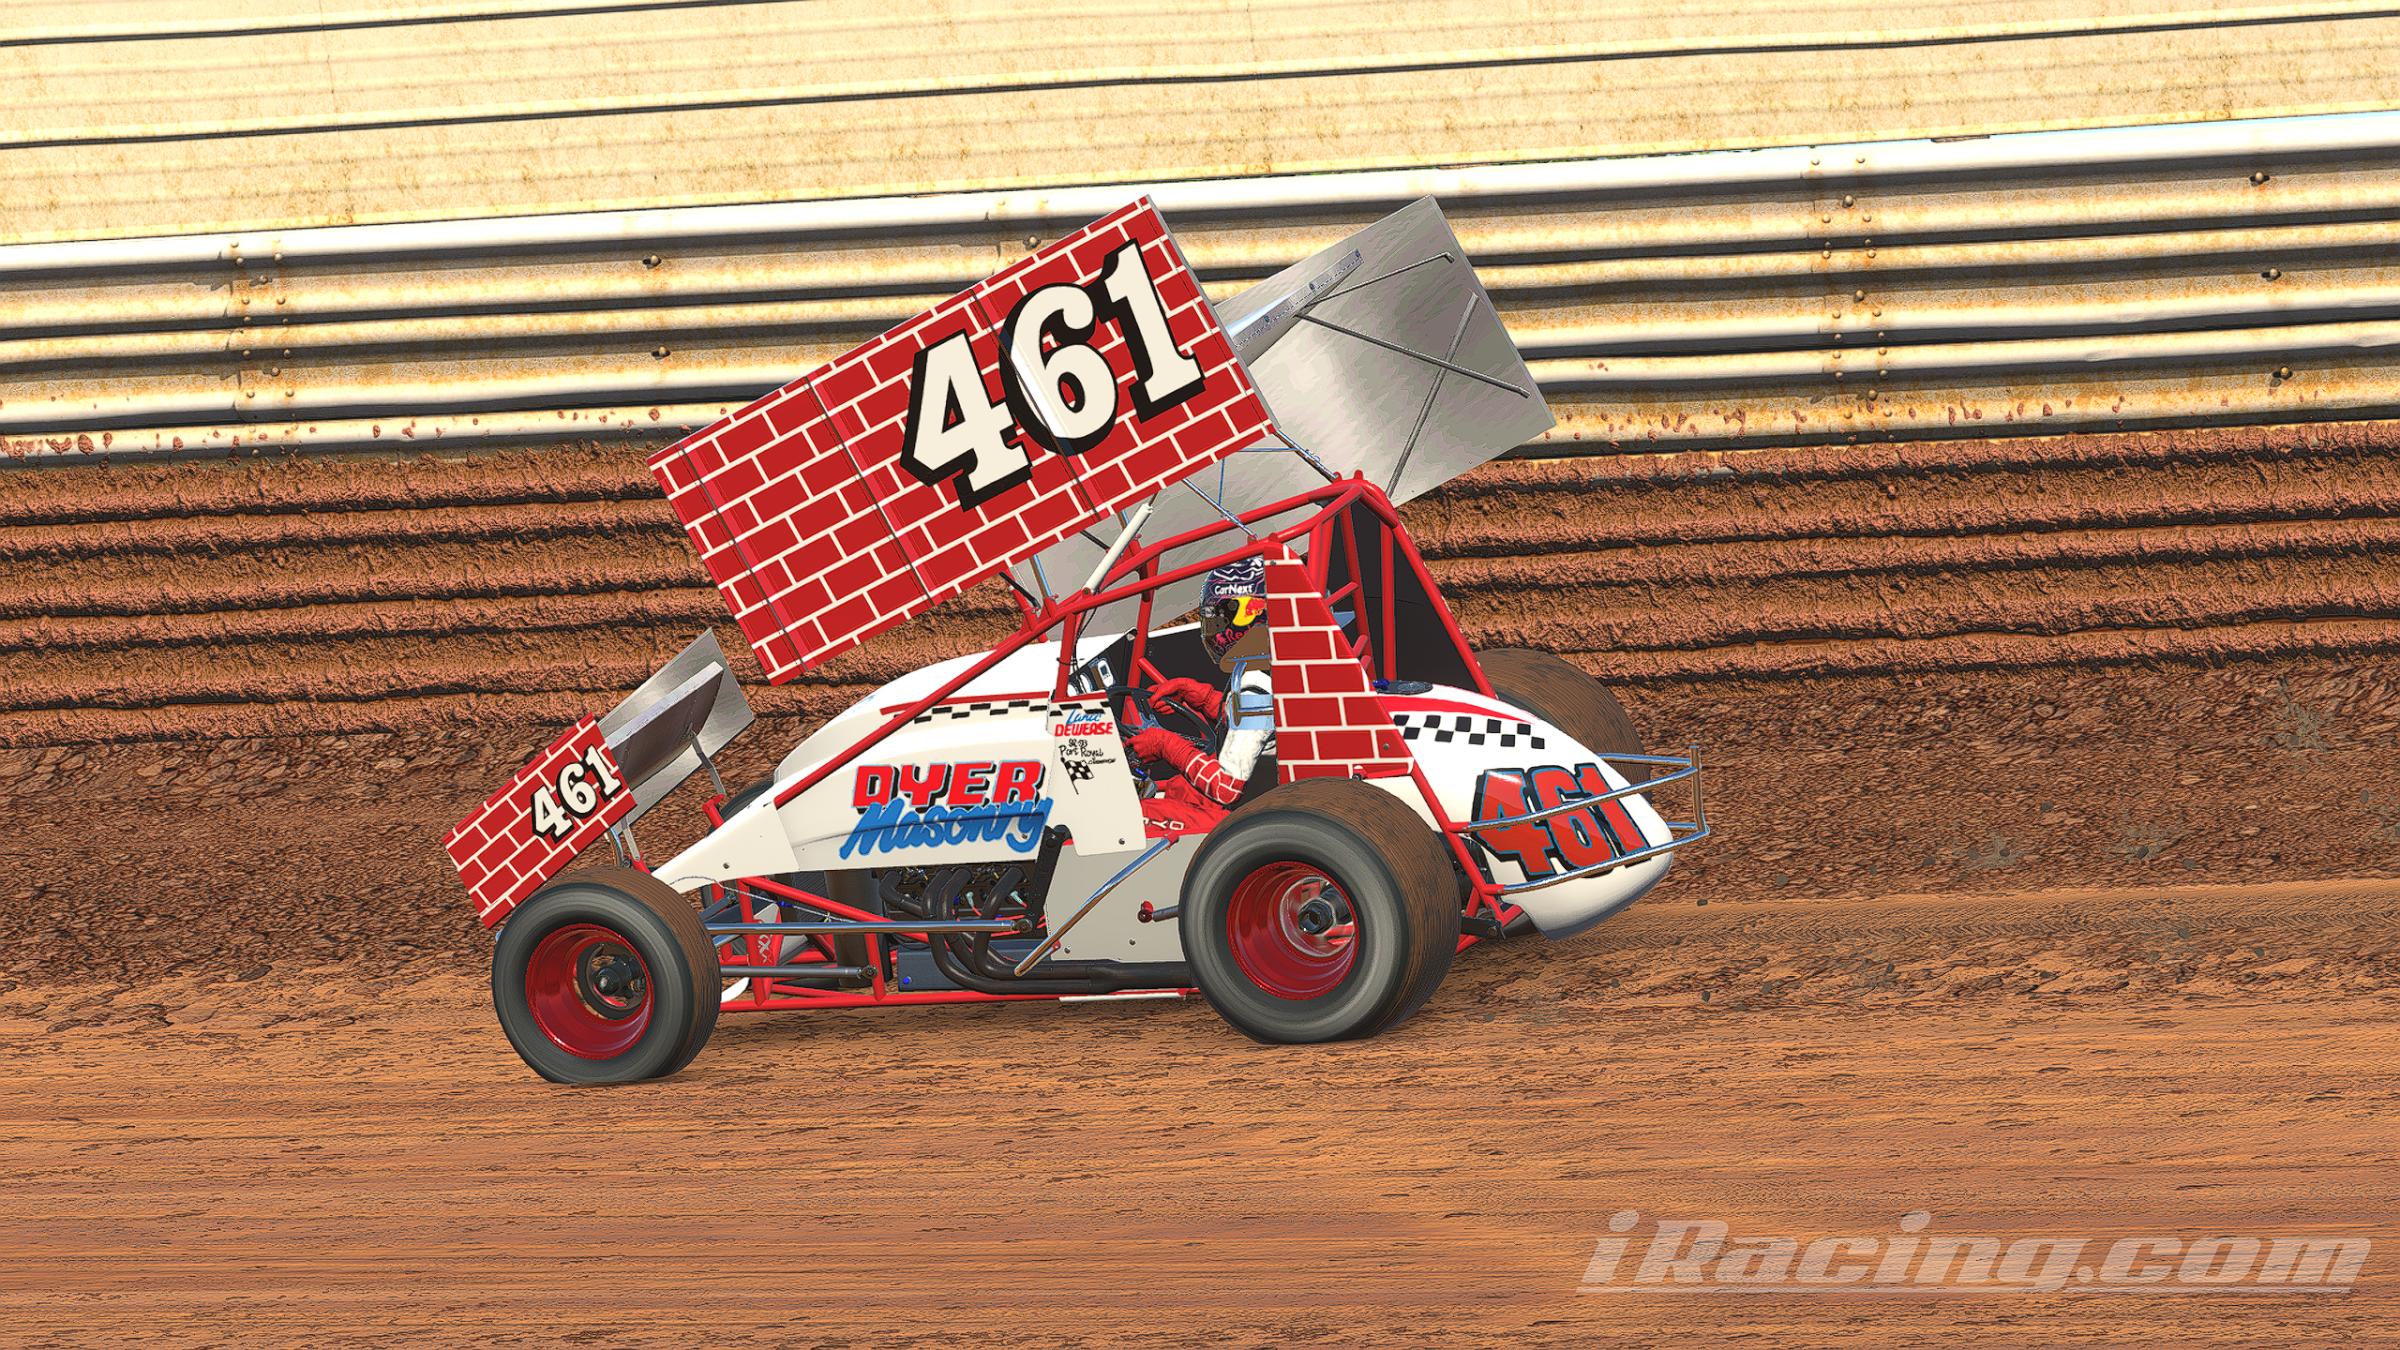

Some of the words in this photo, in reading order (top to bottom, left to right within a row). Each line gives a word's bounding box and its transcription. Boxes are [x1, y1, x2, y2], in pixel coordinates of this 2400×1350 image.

[900, 238, 1206, 512] 461
[1214, 583, 1255, 595] CarNext
[1055, 722, 1113, 737] DEWEASE
[531, 744, 622, 843] 461
[852, 759, 1045, 814] DYER
[839, 796, 1054, 860] Masonry
[1471, 763, 1652, 882] 461
